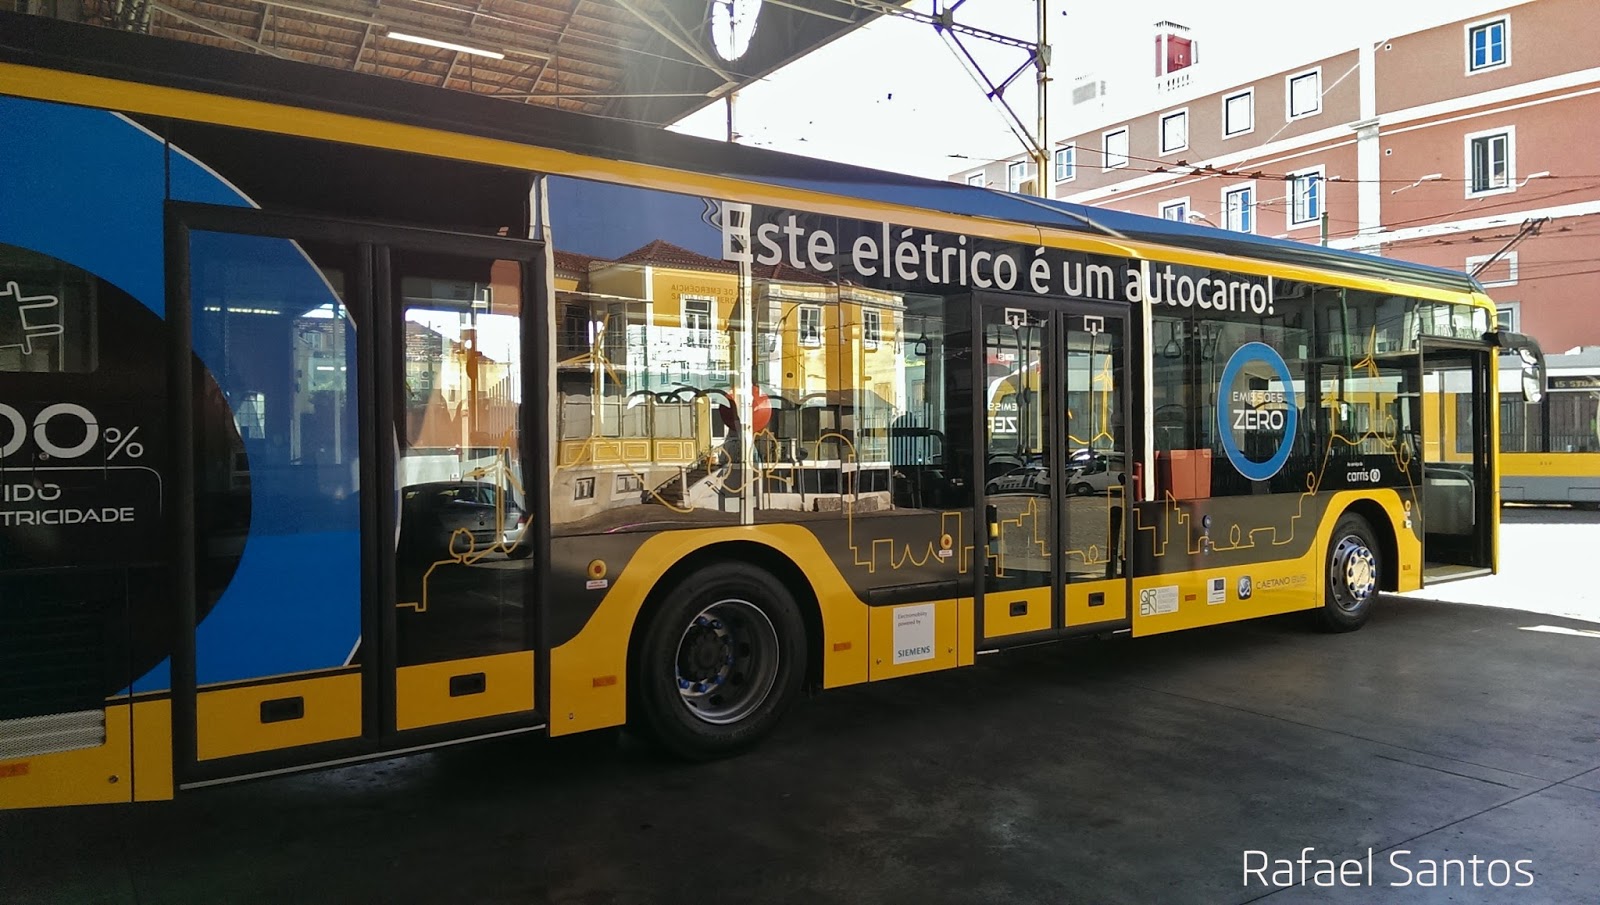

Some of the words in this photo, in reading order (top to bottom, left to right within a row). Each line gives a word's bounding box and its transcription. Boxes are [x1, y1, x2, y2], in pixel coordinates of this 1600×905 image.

[722, 201, 836, 272] Este
[852, 221, 1018, 291] elétrico
[1030, 247, 1051, 294] é
[1063, 261, 1114, 299] um
[1125, 264, 1275, 315] autocarro!
[1233, 409, 1284, 430] ZERO
[1346, 467, 1370, 482] carris
[1255, 576, 1291, 590] CAETANO
[897, 645, 931, 658] SIEMENS
